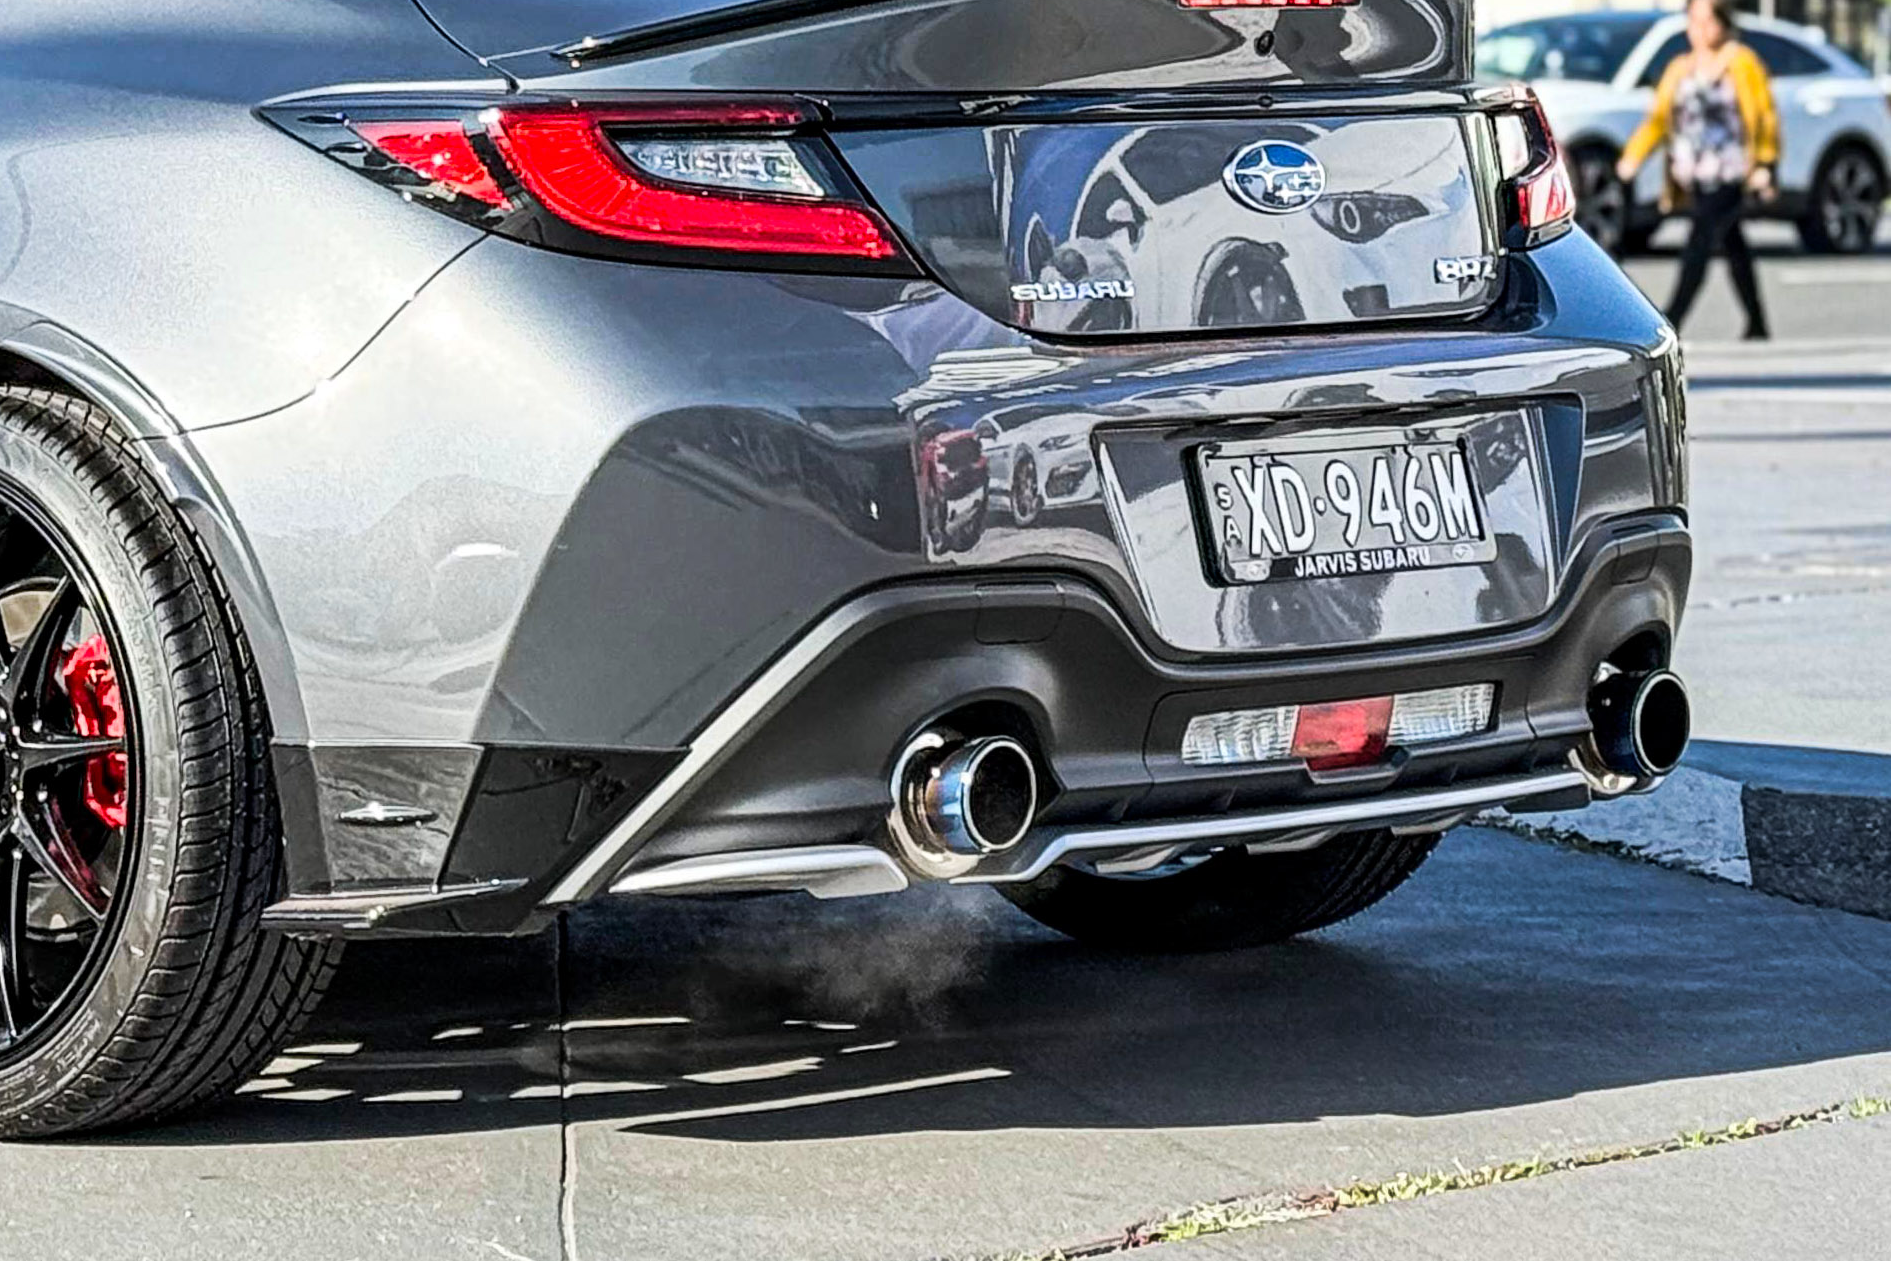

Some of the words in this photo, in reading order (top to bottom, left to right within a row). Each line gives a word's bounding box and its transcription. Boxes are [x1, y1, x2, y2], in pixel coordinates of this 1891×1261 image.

[1010, 279, 1135, 301] SUBARU
[1293, 553, 1358, 578] JARVIS
[1359, 546, 1431, 571] SUBARU
